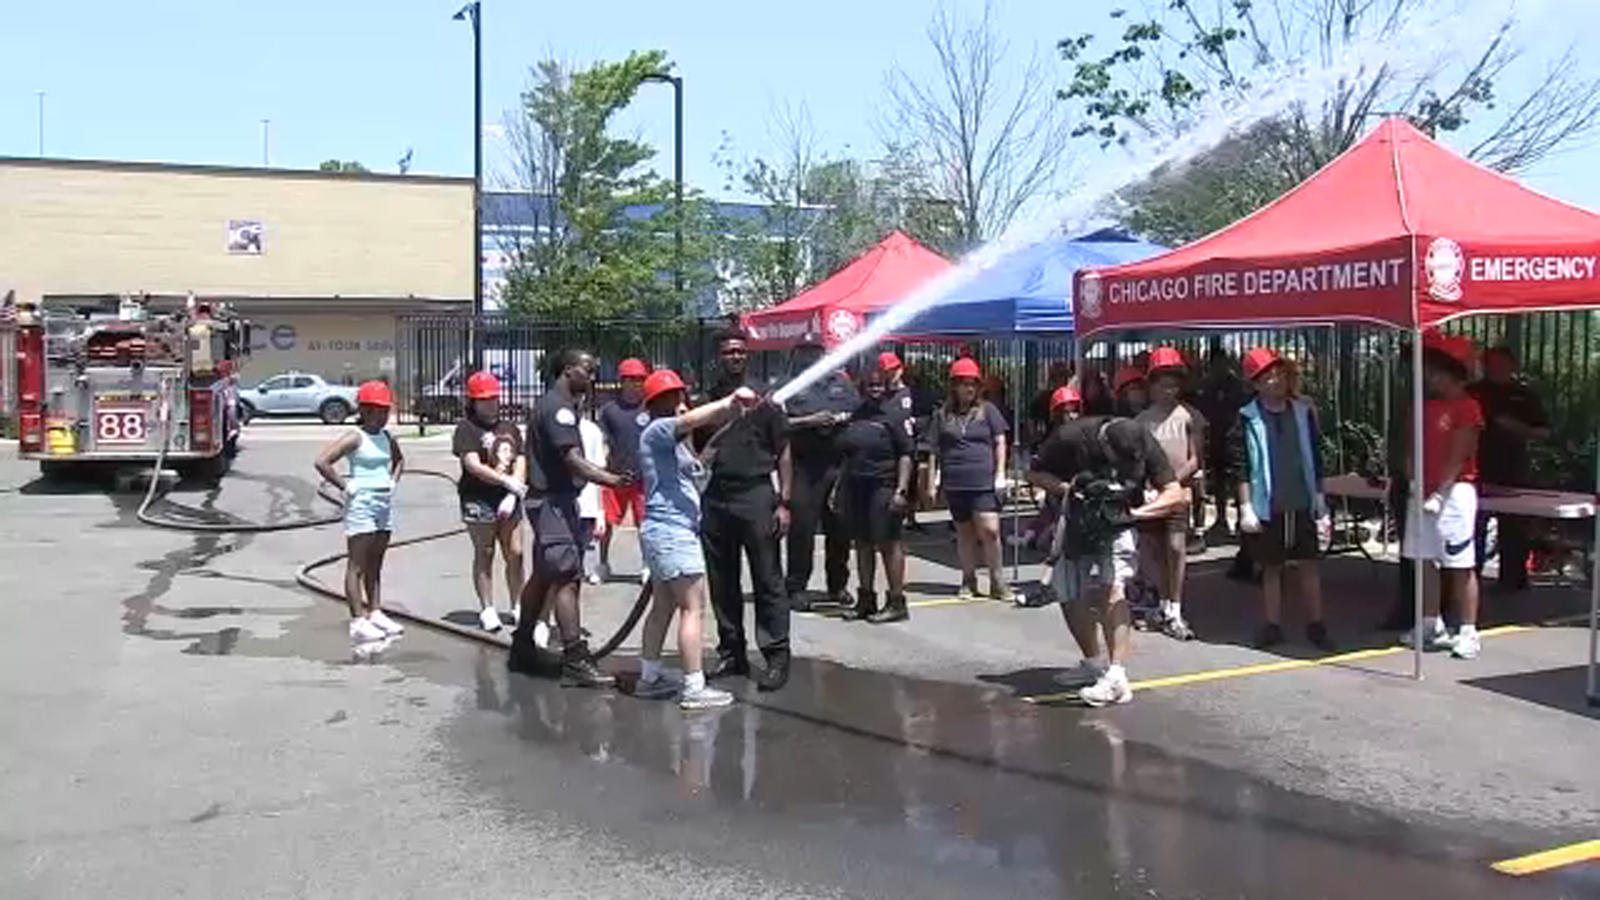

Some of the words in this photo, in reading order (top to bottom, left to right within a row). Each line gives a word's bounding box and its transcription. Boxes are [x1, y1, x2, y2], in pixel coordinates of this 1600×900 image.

[1109, 277, 1189, 304] CHICAGO
[1194, 272, 1239, 298] FIRE
[1244, 258, 1405, 295] DEPARTMENT
[1470, 256, 1596, 281] EMERGENCY
[100, 414, 143, 439] 88
